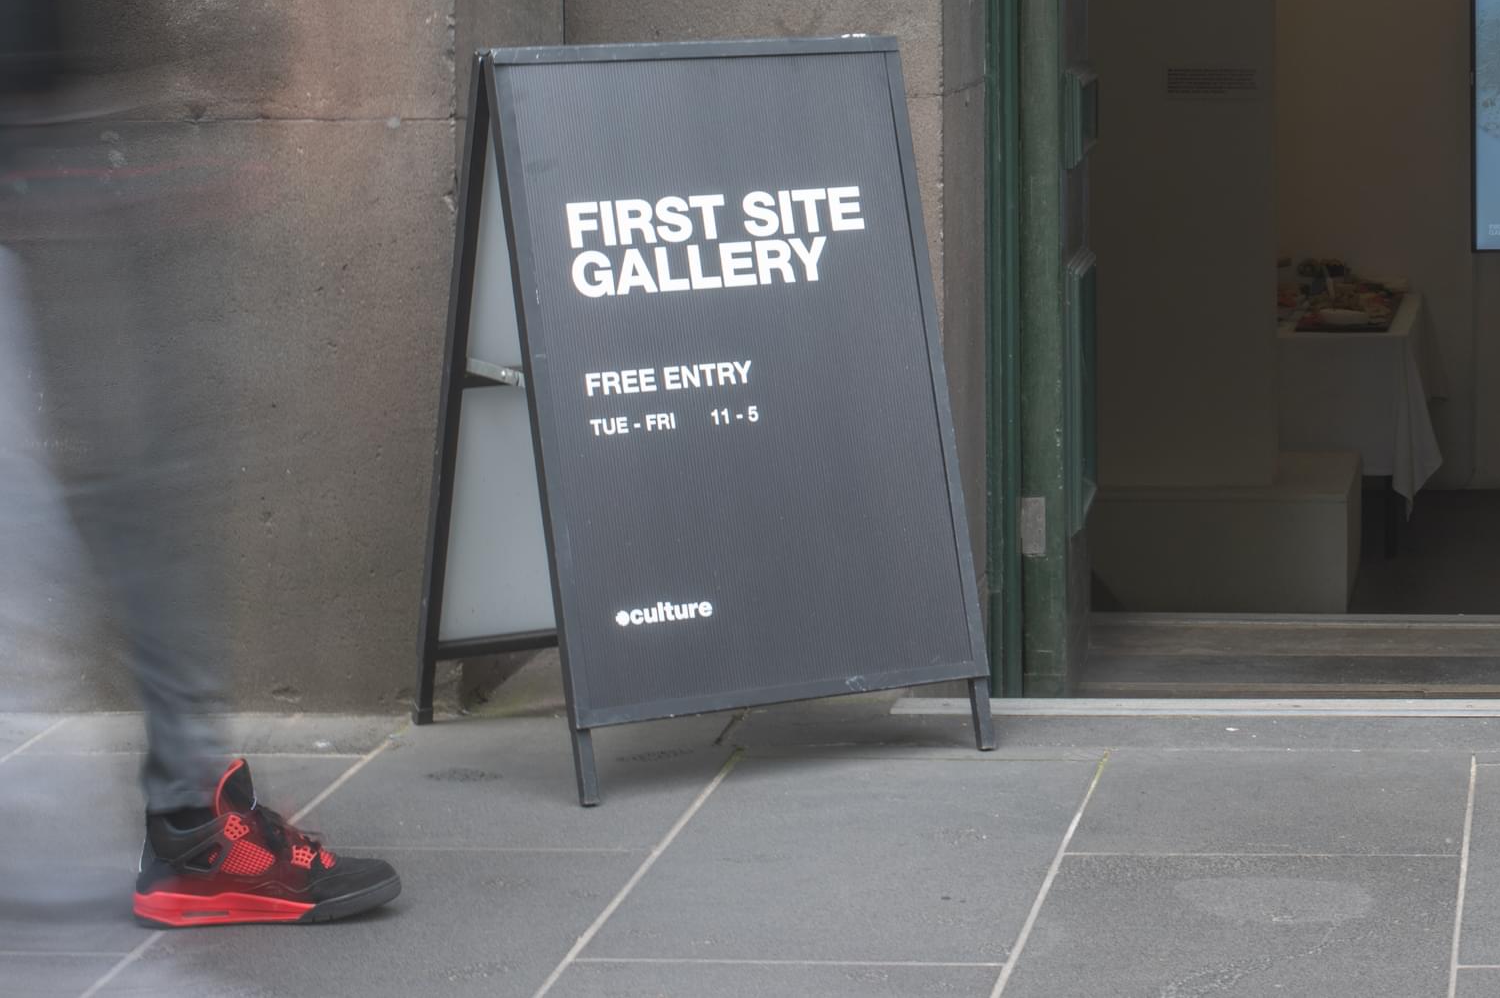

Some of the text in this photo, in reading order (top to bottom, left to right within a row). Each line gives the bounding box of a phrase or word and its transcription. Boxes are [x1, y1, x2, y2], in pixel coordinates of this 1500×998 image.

[565, 186, 866, 250] FIRST SITE
[570, 235, 828, 298] GALLERY
[585, 360, 752, 398] FREE ENTRY
[589, 416, 629, 437] TUE
[645, 412, 677, 432] FRI
[710, 408, 730, 426] 11
[748, 405, 759, 423] 5
[629, 600, 713, 626] culture
